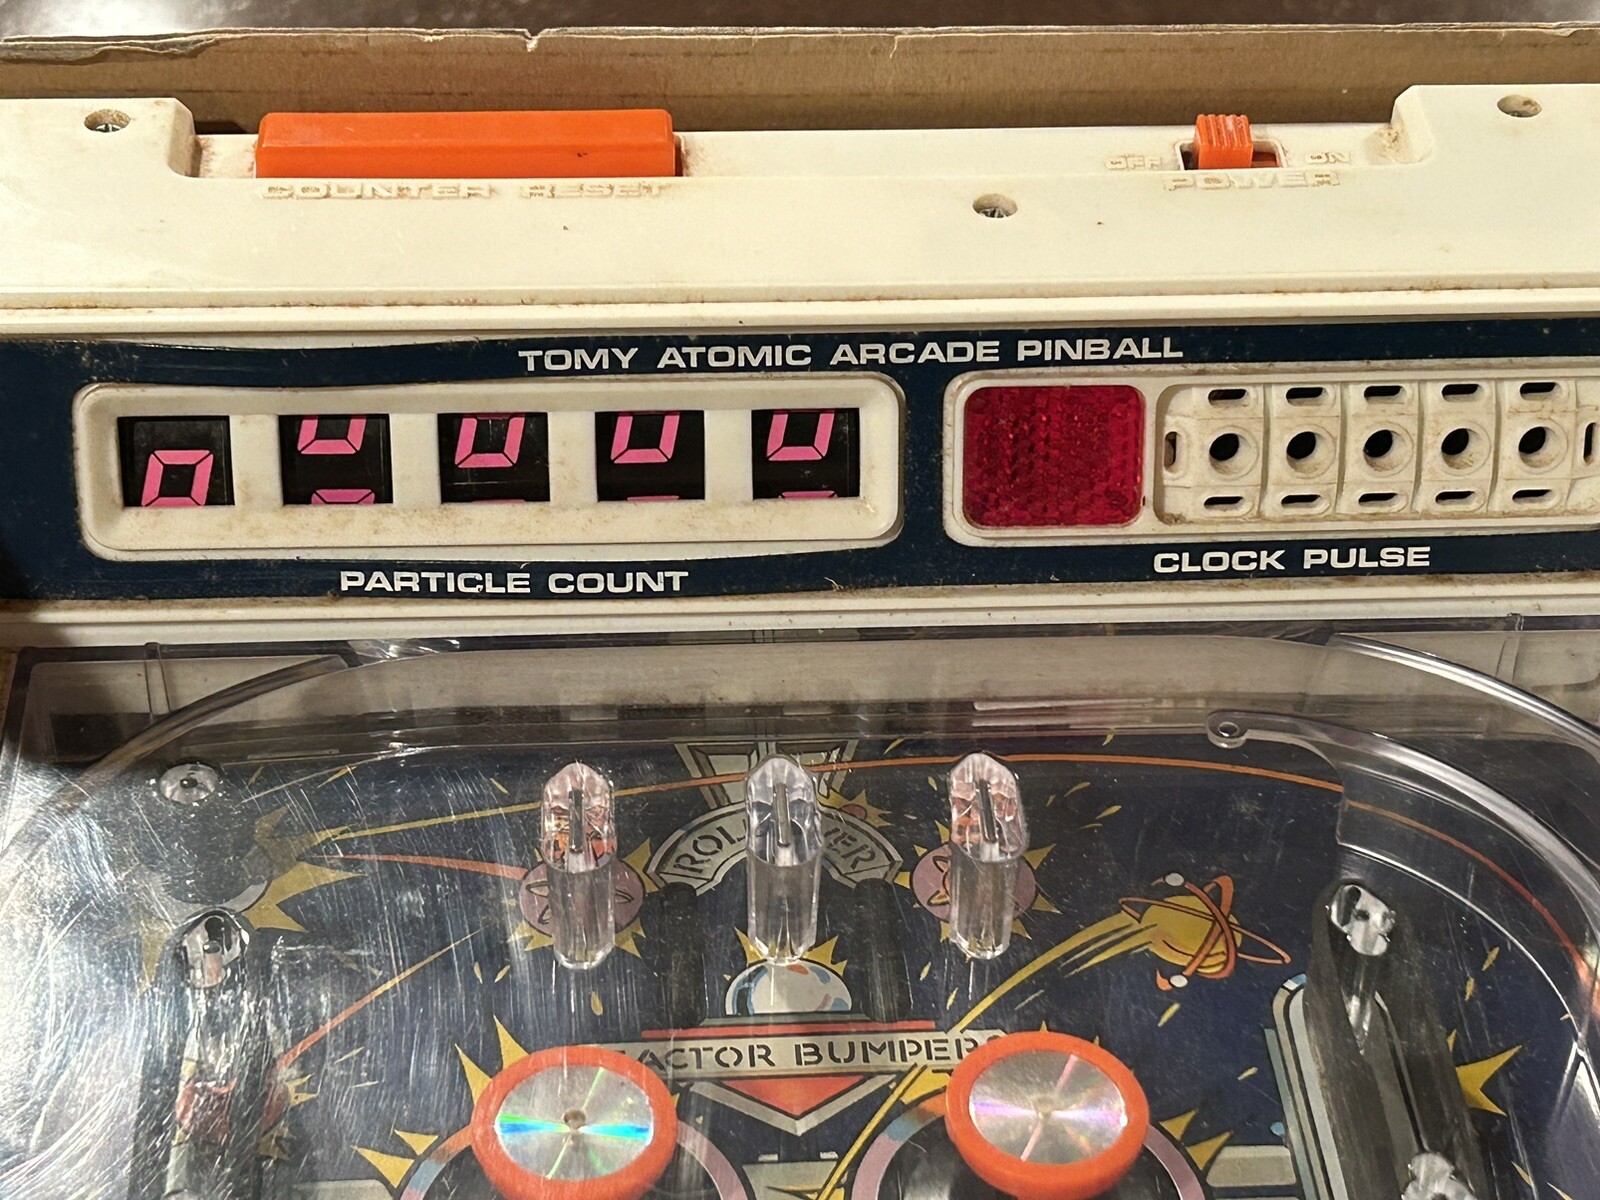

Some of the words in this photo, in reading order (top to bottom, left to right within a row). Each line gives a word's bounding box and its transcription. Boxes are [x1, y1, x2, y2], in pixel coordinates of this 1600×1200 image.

[261, 182, 496, 200] COUNTER
[521, 181, 674, 200] RESET
[1162, 171, 1342, 191] POWER
[518, 347, 639, 372] TOMY
[657, 344, 813, 369] ATOMIC
[829, 340, 1001, 366] ARCADE
[1017, 336, 1184, 362] PINBALL
[1153, 550, 1286, 573] CLOCK
[1303, 546, 1431, 570] PULSE
[340, 571, 531, 592] PARTICLE
[549, 571, 689, 594] COUNT
[618, 1044, 776, 1071] ACTOR
[794, 1035, 1001, 1066] BUMPER
